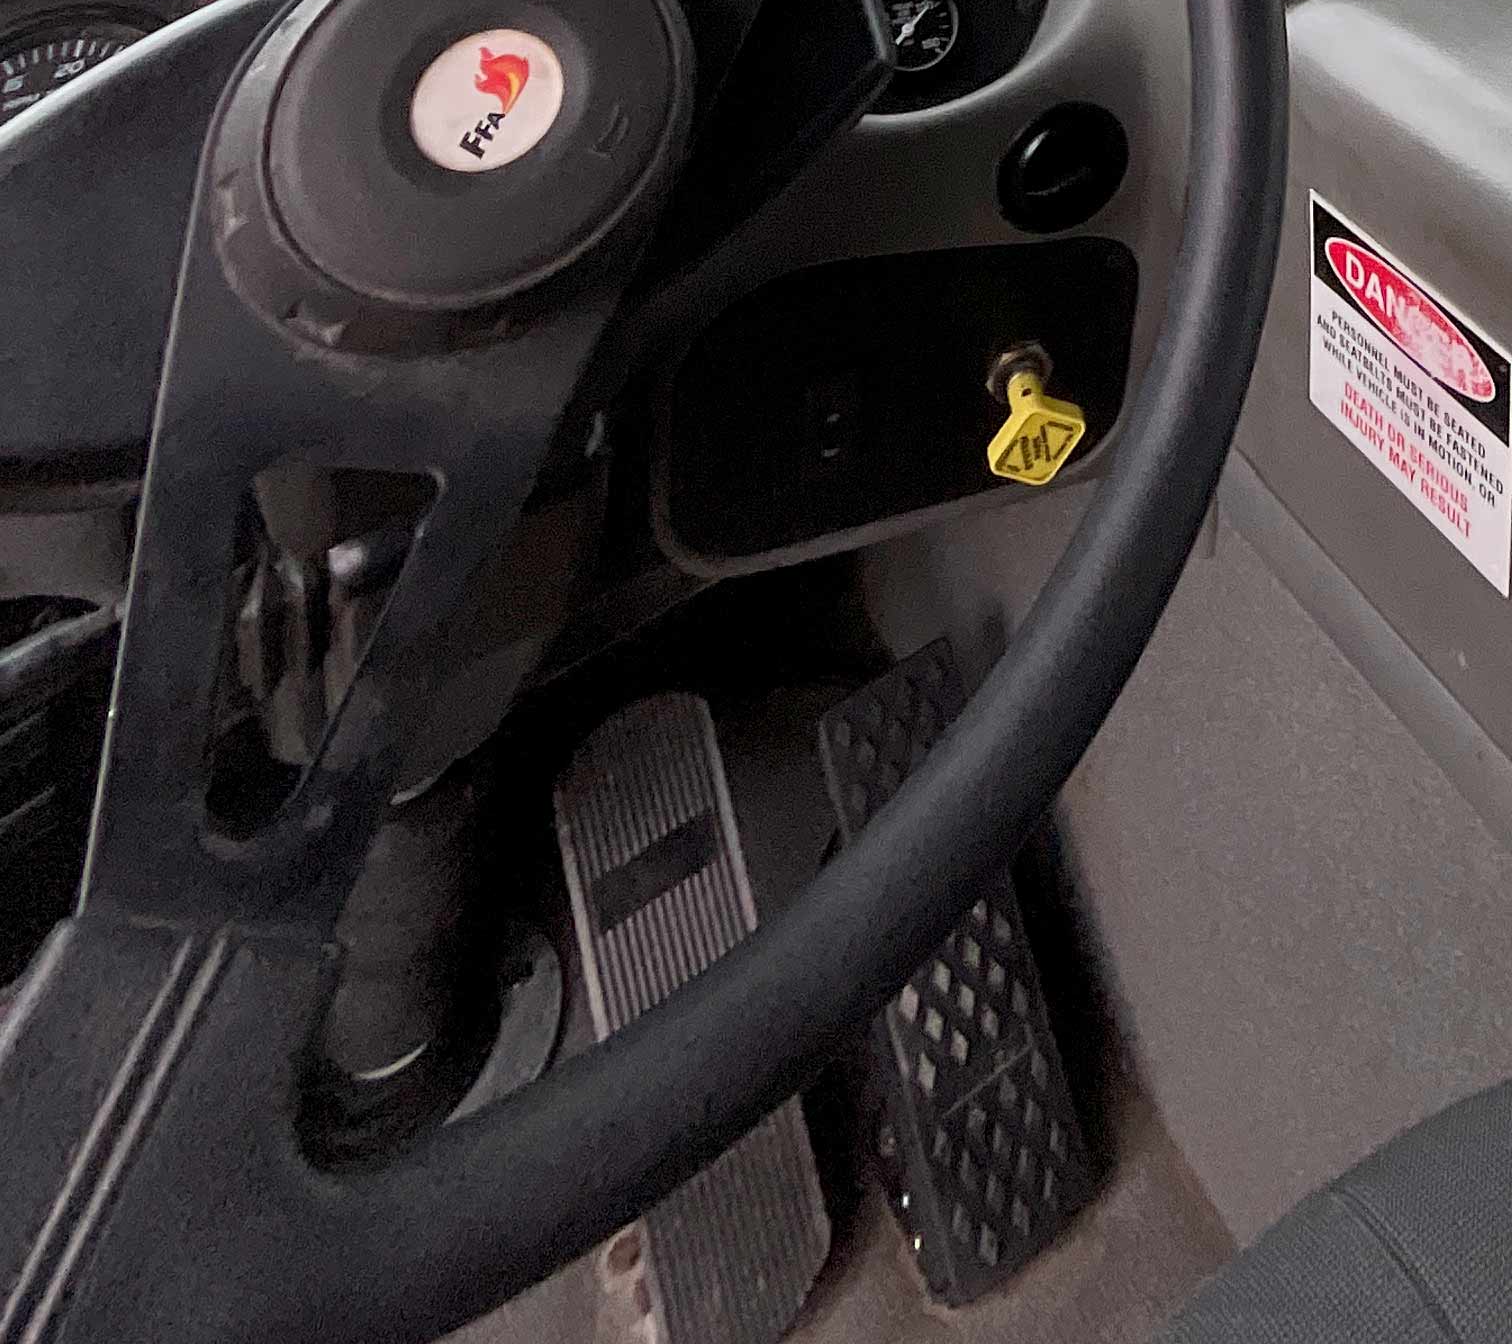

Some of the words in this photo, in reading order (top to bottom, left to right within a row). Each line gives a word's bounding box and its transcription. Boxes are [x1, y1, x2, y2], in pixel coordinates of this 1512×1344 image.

[460, 112, 506, 160] FFA
[1317, 314, 1337, 340] AND
[1339, 334, 1393, 392] SEATBELTS
[1396, 387, 1426, 421] MUST
[1430, 417, 1442, 439] BE
[1446, 434, 1504, 495] FASTENED
[1323, 336, 1352, 372] WHILE
[1357, 367, 1397, 414] VEHICLE
[1401, 412, 1411, 428] IS
[1413, 422, 1426, 441] IN
[1479, 484, 1496, 509] OR
[1331, 310, 1390, 371] PERSONNEL
[1394, 365, 1423, 401] MUST
[1427, 397, 1440, 417] BE
[1444, 412, 1486, 459] SEATED
[1345, 382, 1384, 431] DEATH
[1388, 423, 1405, 452] OR
[1409, 443, 1469, 513] SERIOUS
[1340, 399, 1386, 452] INJURY
[1389, 447, 1417, 484] MAY
[1421, 478, 1473, 539] RESULT
